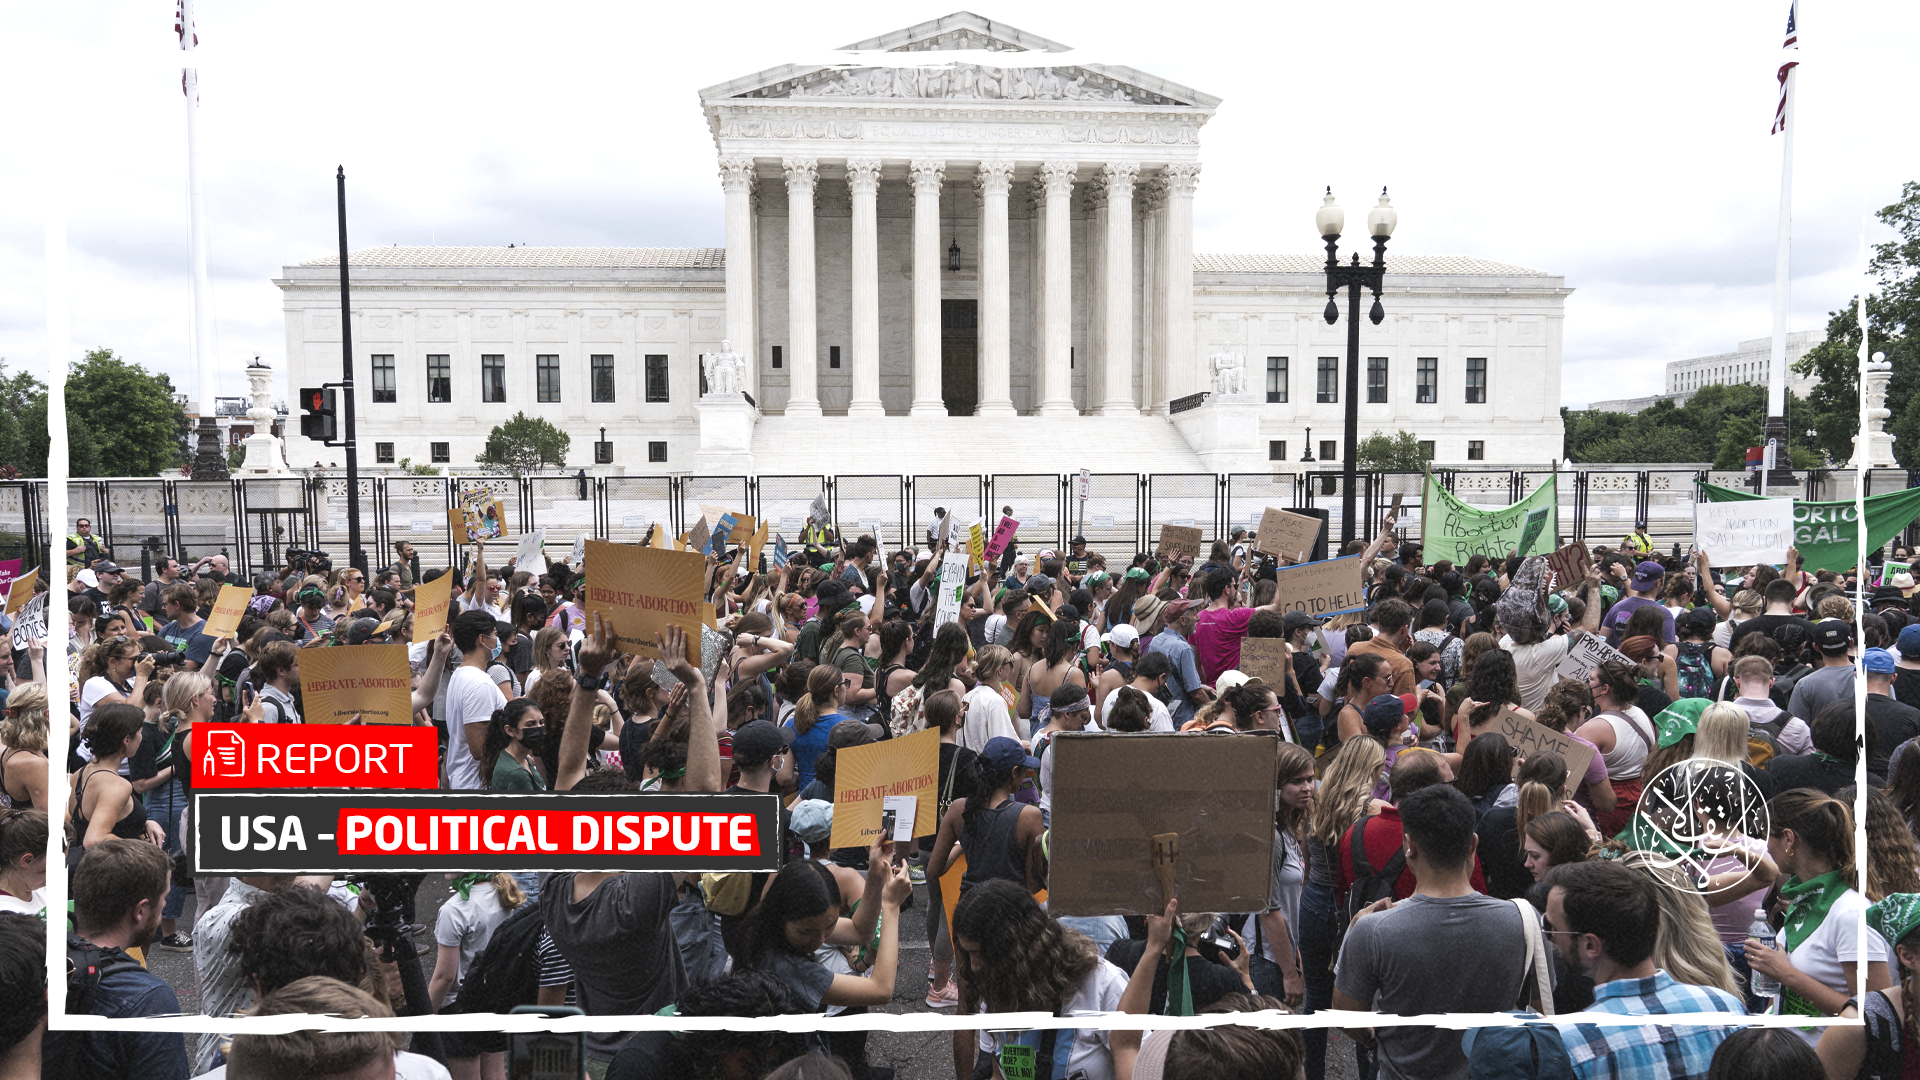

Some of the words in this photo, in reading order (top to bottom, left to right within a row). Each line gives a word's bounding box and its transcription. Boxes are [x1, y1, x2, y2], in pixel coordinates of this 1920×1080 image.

[873, 126, 916, 138] EQUAL
[921, 127, 973, 138] JUSTICE
[979, 128, 1021, 139] UNDER
[1027, 129, 1053, 139] LAW
[1709, 505, 1740, 518] KEEP
[1280, 516, 1305, 529] MEAN
[1725, 518, 1779, 530] ABORTION
[1706, 532, 1741, 548] SAFE
[942, 562, 967, 584] EXPAND
[590, 587, 634, 608] LIBERATE
[636, 594, 697, 617] ABORTION
[1307, 596, 1327, 614] TO
[1328, 591, 1362, 612] HELL
[14, 619, 49, 647] BODIES
[307, 677, 358, 693] LIBERATE
[359, 677, 407, 689] ABORTION
[1501, 716, 1568, 755] SHAME
[840, 784, 888, 804] LIBERATE
[889, 773, 934, 797] ABORTION
[1003, 1046, 1031, 1057] OVERTURN
[1003, 1055, 1018, 1065] ROE?
[1004, 1066, 1020, 1077] HELL
[1021, 1067, 1033, 1079] NO!
